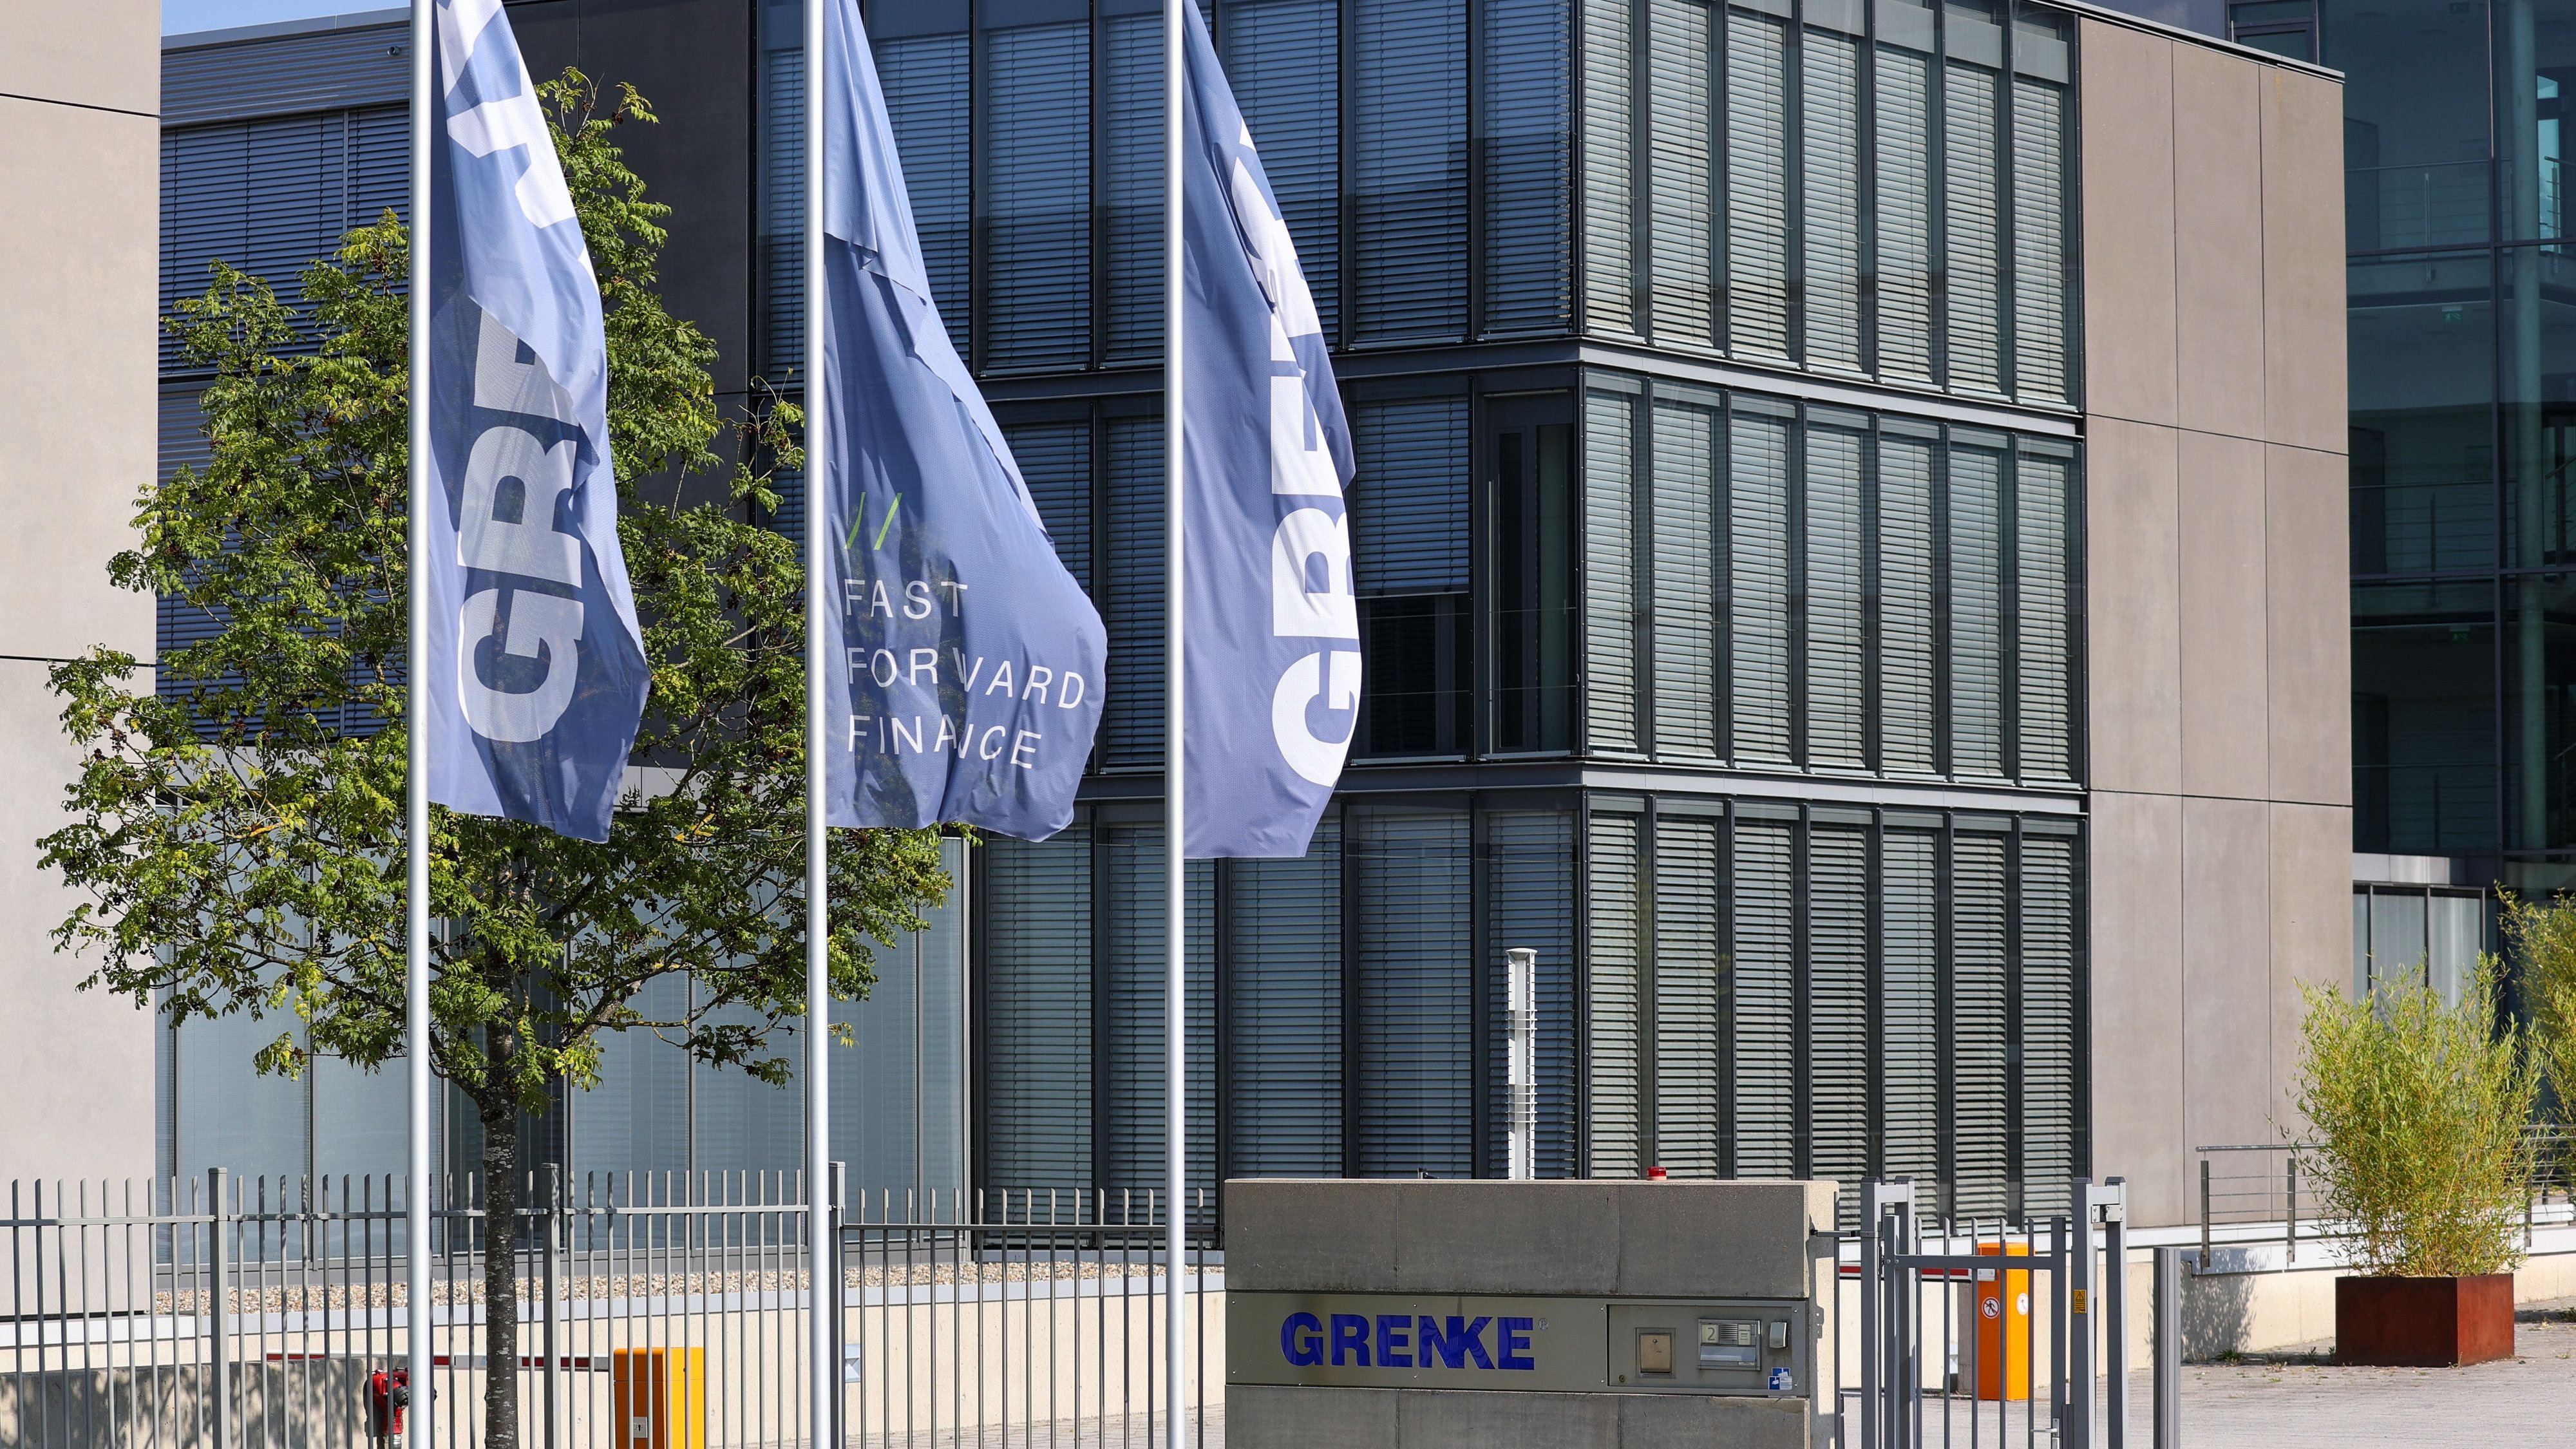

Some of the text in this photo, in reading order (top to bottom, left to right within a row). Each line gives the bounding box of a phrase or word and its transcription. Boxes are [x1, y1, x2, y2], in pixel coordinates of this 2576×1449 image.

[844, 578, 968, 620] FAST
[848, 646, 1084, 709] FORWARD
[1707, 1327, 1716, 1341] 2
